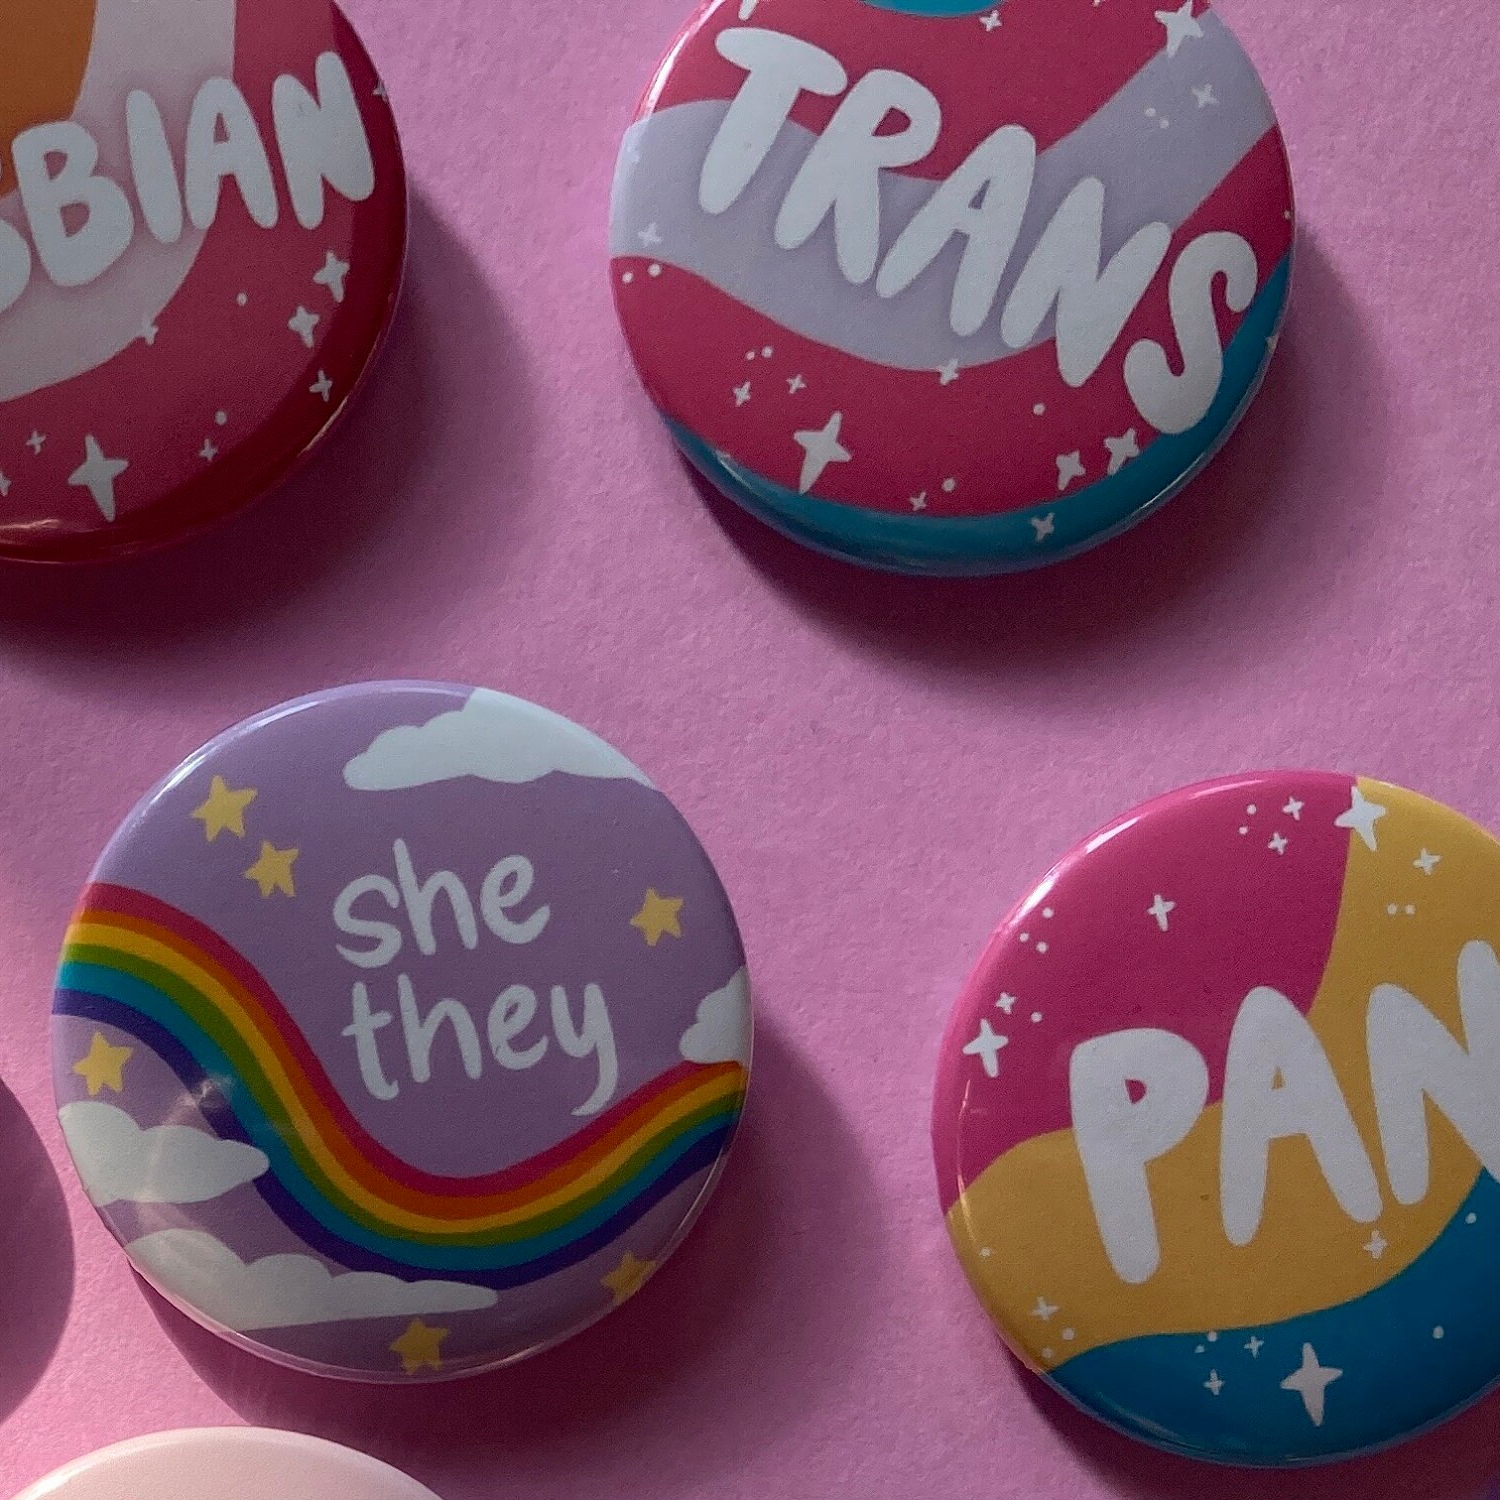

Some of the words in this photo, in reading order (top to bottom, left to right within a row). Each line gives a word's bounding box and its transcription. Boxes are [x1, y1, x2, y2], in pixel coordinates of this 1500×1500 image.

[700, 28, 1258, 435] TRANS
[334, 838, 550, 967] she
[342, 970, 618, 1117] they
[1069, 938, 1500, 1284] PAN
